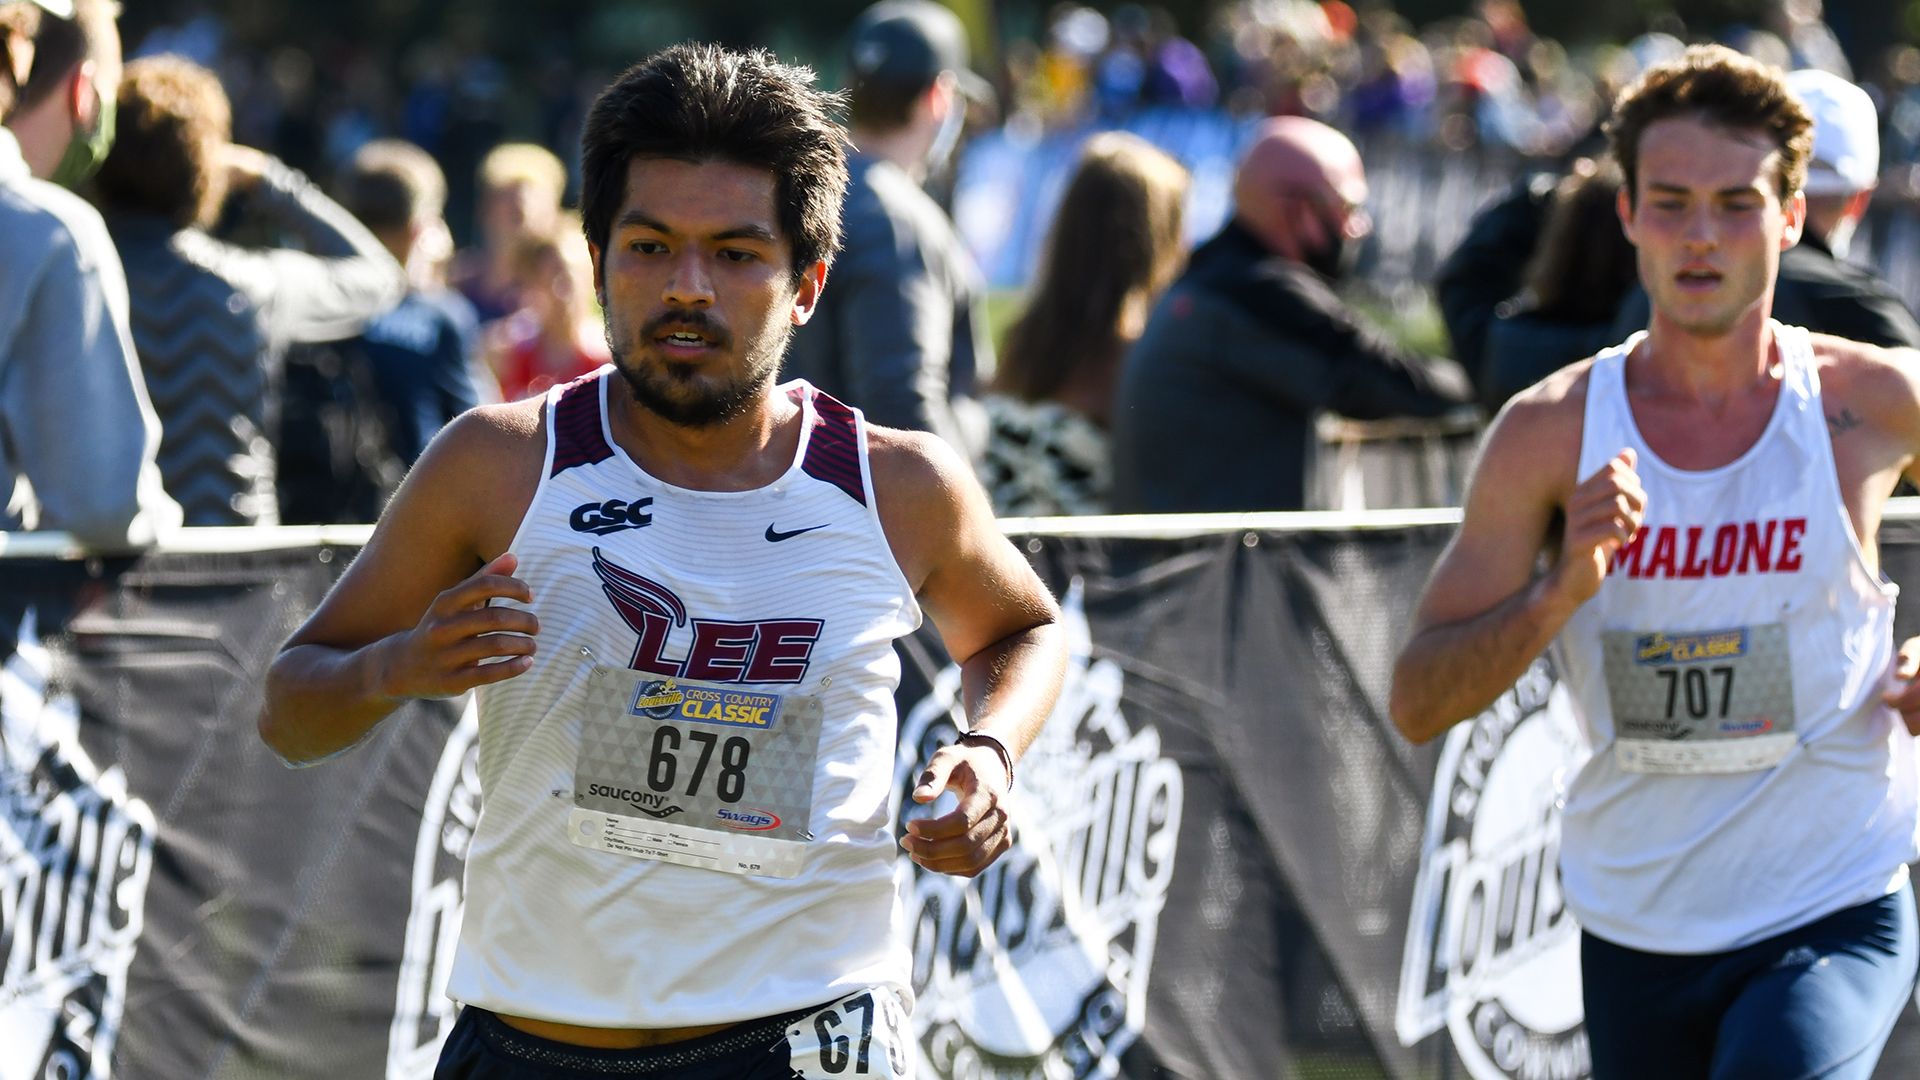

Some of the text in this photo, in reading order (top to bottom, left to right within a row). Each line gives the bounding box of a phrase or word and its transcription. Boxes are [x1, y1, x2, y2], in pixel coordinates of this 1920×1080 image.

[570, 497, 653, 536] GSC
[1605, 519, 1806, 580] MALONE
[628, 611, 825, 685] LEE
[637, 690, 685, 708] Louisville
[681, 700, 771, 725] CLASSIC
[686, 689, 776, 707] CROSS COUNTRY
[1656, 667, 1734, 720] 707
[647, 725, 750, 803] 678
[588, 783, 665, 808] saucony
[716, 808, 772, 825] Swags
[814, 993, 907, 1076] 678
